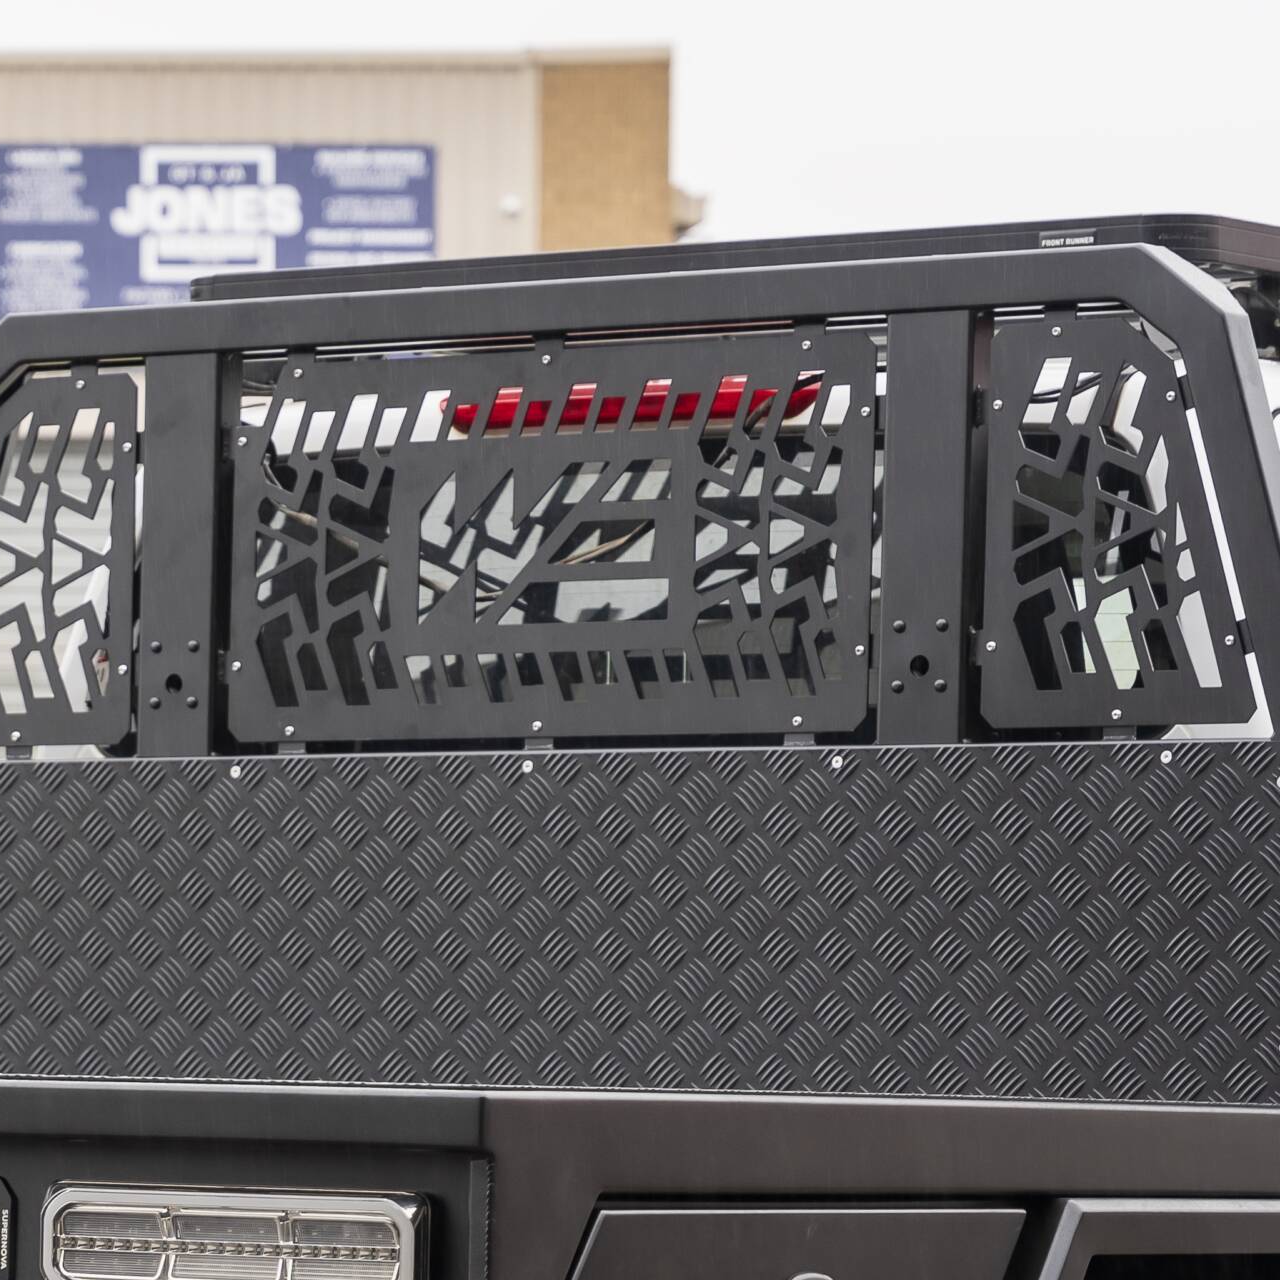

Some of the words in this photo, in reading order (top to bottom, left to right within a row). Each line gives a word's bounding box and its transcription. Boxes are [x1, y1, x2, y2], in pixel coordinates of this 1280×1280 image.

[110, 183, 303, 236] JONES
[1041, 237, 1064, 247] FRONT
[1065, 236, 1094, 245] RUNNER
[0, 1209, 8, 1270] SUPERNOVA
